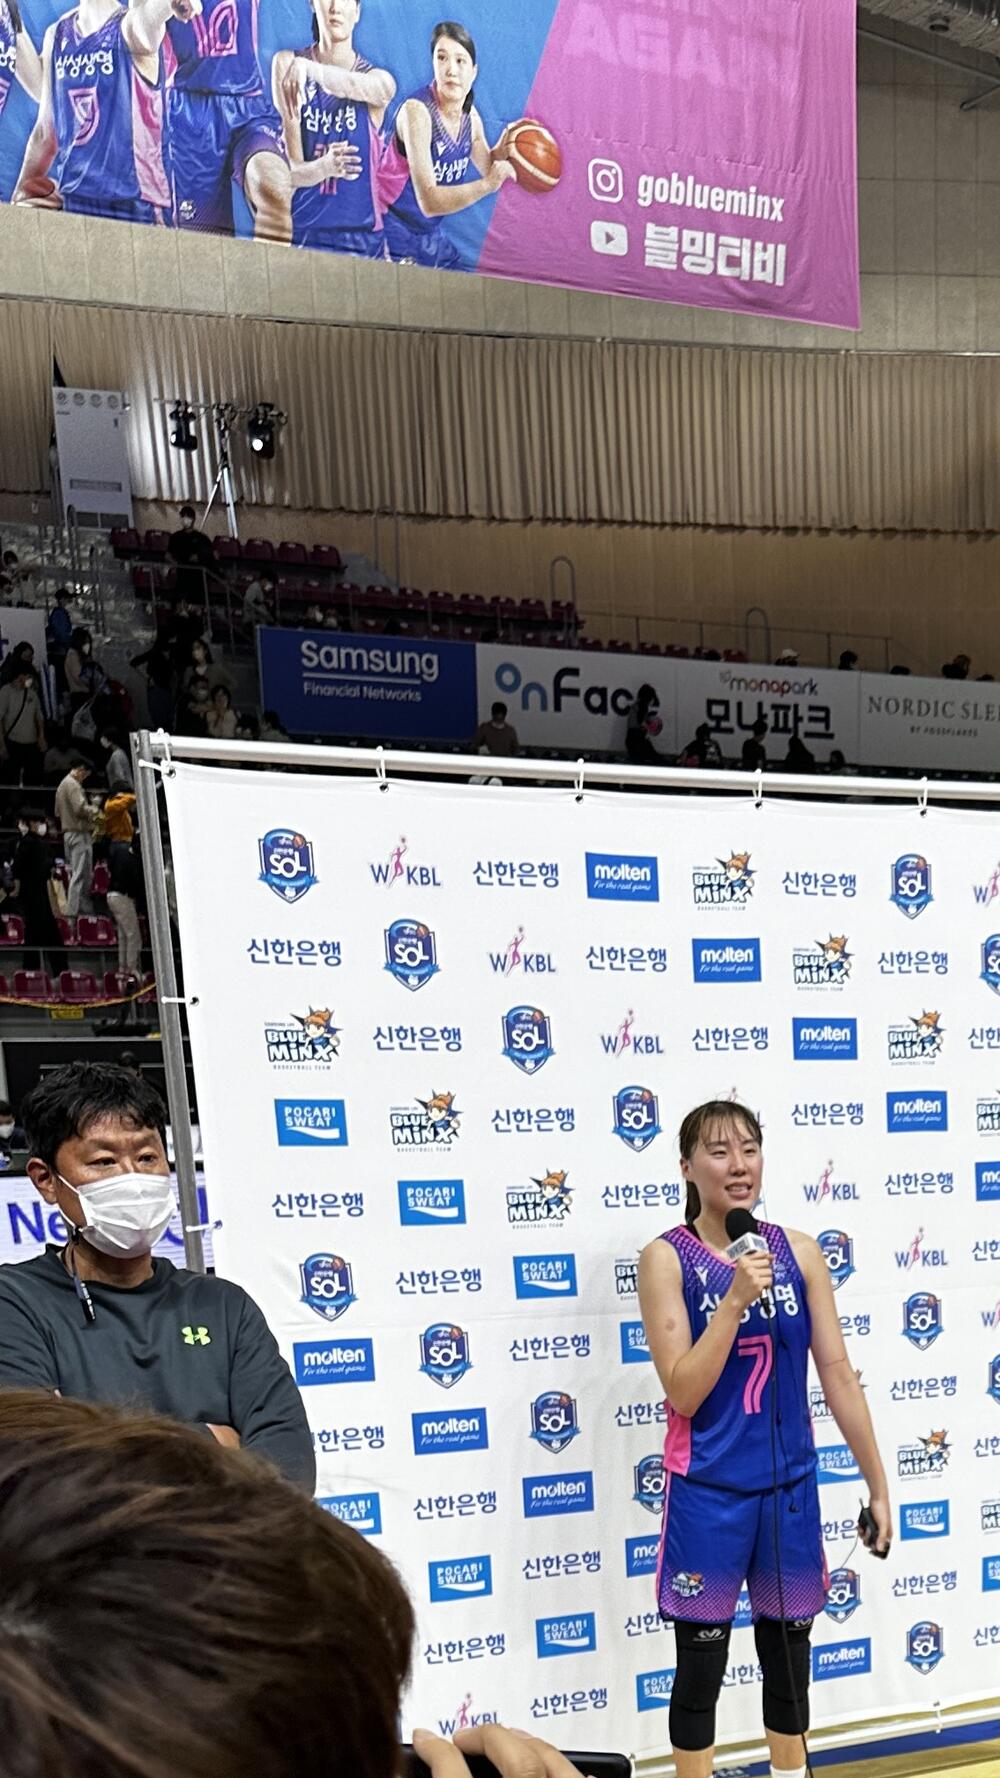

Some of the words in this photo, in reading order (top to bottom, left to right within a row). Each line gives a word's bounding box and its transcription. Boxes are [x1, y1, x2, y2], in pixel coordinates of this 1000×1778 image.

[55, 51, 114, 79] 삼성생명
[637, 171, 786, 223] goblueminx
[643, 221, 787, 287] 블밍티비
[301, 640, 438, 681] Samsung
[303, 682, 360, 698] Financial
[362, 685, 422, 702] Networks
[729, 674, 818, 698] monopark
[867, 695, 955, 720] NORDIC
[706, 698, 835, 740] 모나파크
[473, 862, 558, 887] 신한은행
[594, 863, 651, 882] molten
[693, 873, 728, 886] BLUE
[782, 872, 856, 897] 신한은행
[247, 939, 341, 966] 신한은행
[586, 947, 666, 972] 신한은행
[700, 945, 754, 965] molten
[794, 954, 825, 967] BLUE
[878, 951, 948, 974] 신한은행
[265, 1029, 308, 1045] BLUE
[373, 1026, 461, 1051] 신한은행
[693, 1027, 768, 1051] 신한은행
[800, 1026, 850, 1043] molten
[888, 1031, 918, 1043] BLUE
[284, 1106, 335, 1118] POCARI
[792, 1103, 863, 1125] 신한은행
[894, 1100, 941, 1115] molten
[285, 1116, 331, 1127] SWEAT
[390, 1114, 430, 1128] BLUE
[492, 1108, 574, 1132] 신한은행
[407, 1187, 455, 1198] POCARI
[885, 1172, 953, 1195] 신한은행
[272, 1193, 363, 1217] 신한은행
[408, 1196, 450, 1207] SWEAT
[507, 1192, 545, 1205] BLUE
[602, 1184, 680, 1208] 신한은행
[7, 1200, 69, 1245] Ne
[522, 1262, 567, 1273] POCARI
[523, 1270, 563, 1281] SWEAT
[396, 1269, 481, 1294] 신한은행
[304, 1348, 365, 1365] molten
[510, 1335, 590, 1361] 신한은행
[737, 1334, 773, 1415] 7
[890, 1376, 956, 1400] 신한은행
[421, 1417, 479, 1435] molten
[314, 1426, 384, 1455] 한은행
[899, 1449, 928, 1461] BLUE
[531, 1481, 585, 1499] molten
[414, 1491, 496, 1520] 신한은행
[906, 1509, 943, 1518] POCARI
[906, 1515, 939, 1526] SWEAT
[437, 1563, 483, 1575] POCARI
[523, 1551, 600, 1579] 신한은행
[438, 1571, 480, 1584] SWEAT
[892, 1571, 956, 1597] 신한은행
[544, 1621, 587, 1632] POCARI
[544, 1629, 584, 1640] SWEAT
[425, 1634, 505, 1664] 신한은행
[819, 1646, 865, 1664] molten
[531, 1688, 607, 1718] 신한은행
